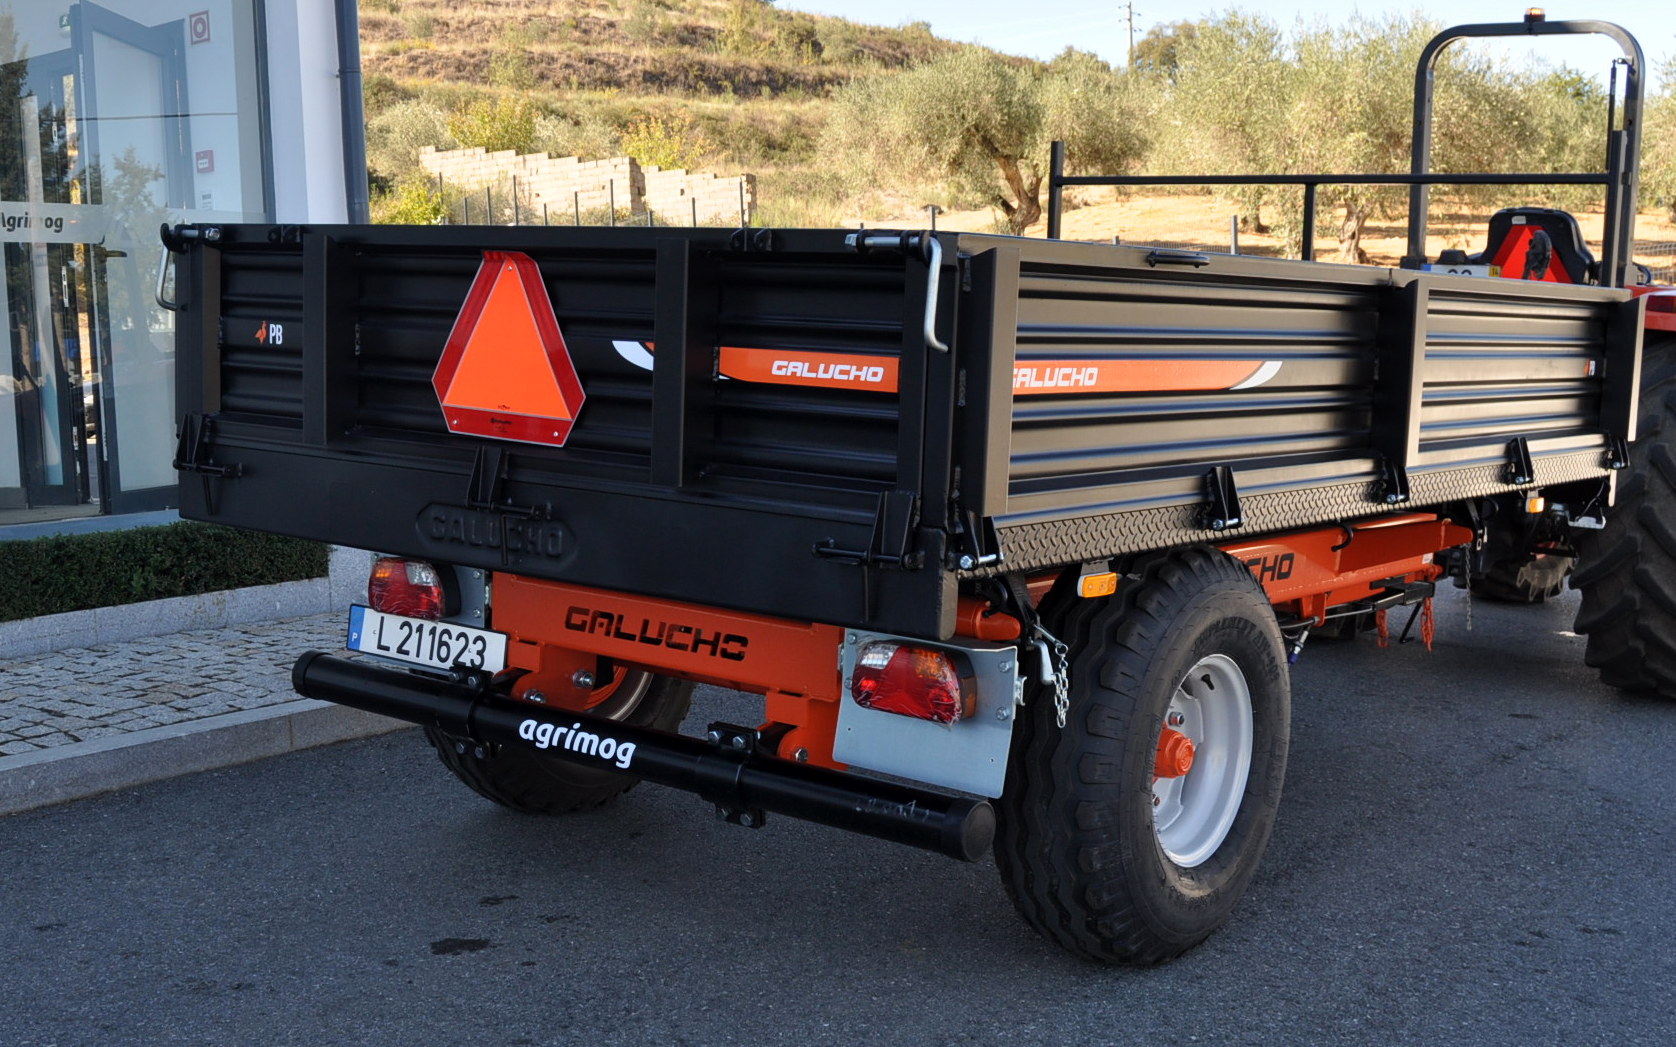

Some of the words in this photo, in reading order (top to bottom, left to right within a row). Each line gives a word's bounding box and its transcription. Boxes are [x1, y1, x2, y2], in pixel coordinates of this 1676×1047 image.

[0, 211, 63, 233] griog
[269, 323, 283, 345] PB
[771, 360, 884, 382] GALUCHO
[431, 515, 564, 558] GALUCHO
[351, 631, 358, 642] P
[565, 605, 749, 662] GALUCHO
[518, 718, 637, 769] agrimog
